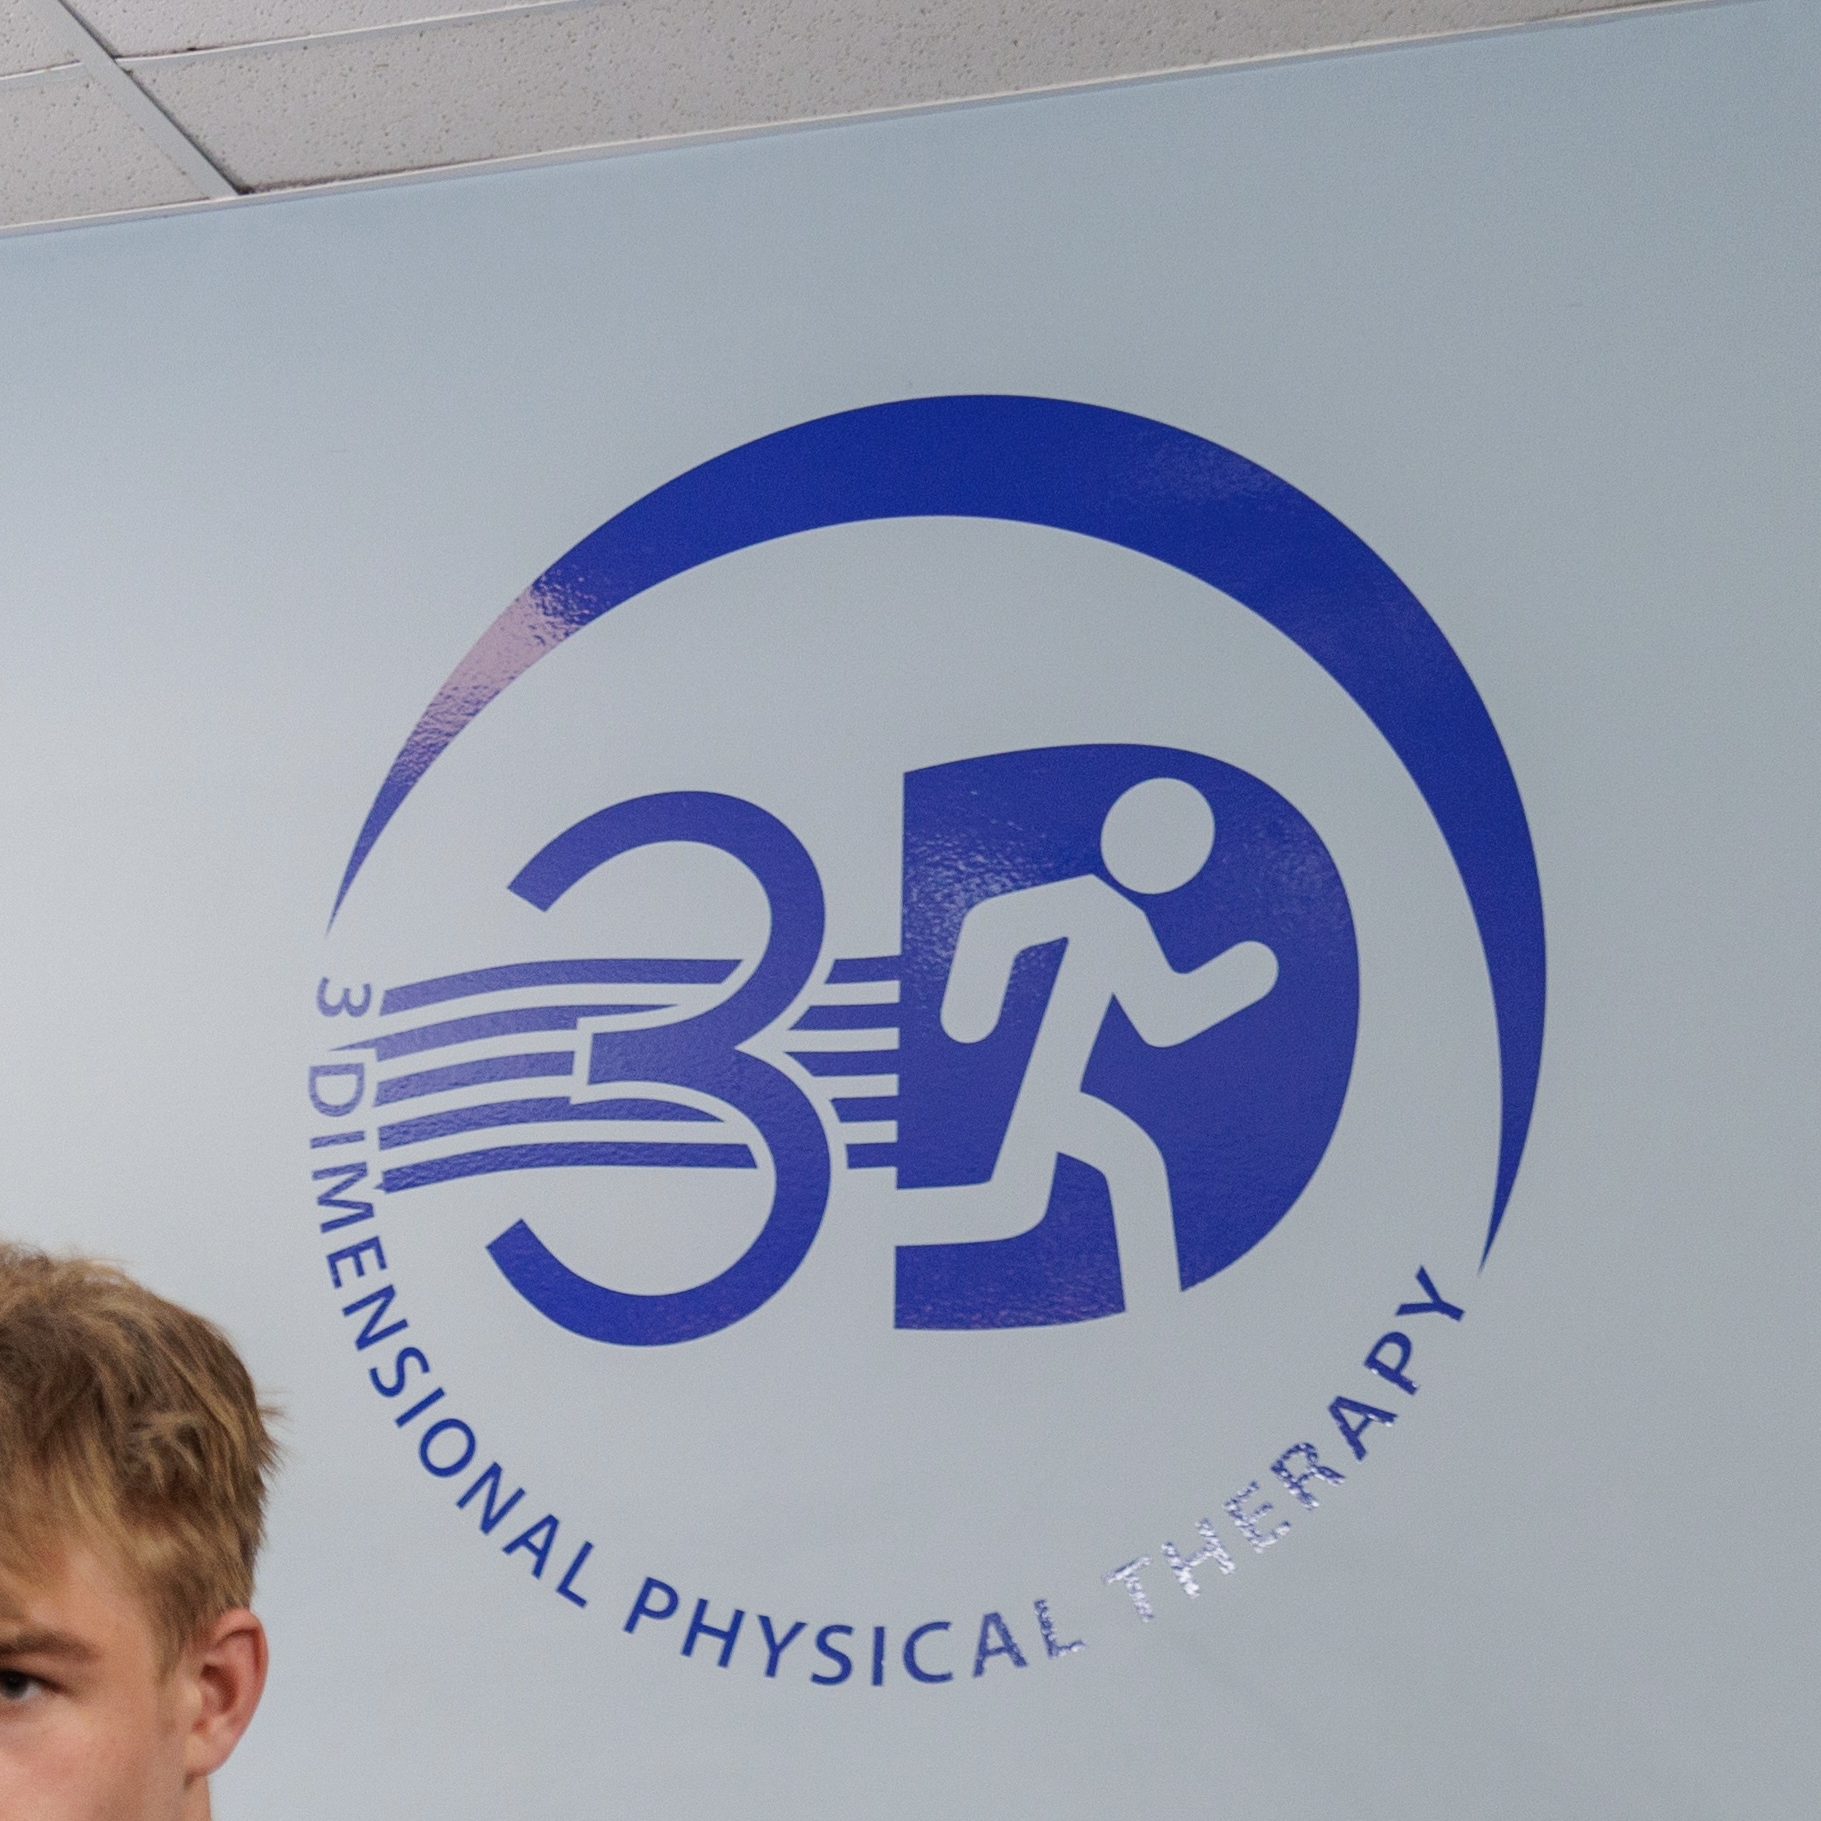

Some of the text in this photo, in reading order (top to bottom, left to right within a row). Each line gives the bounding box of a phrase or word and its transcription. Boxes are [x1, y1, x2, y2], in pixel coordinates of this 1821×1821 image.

[307, 976, 1466, 1687] 3 DIMENSIONAL PHYSICAL THERAPY
[485, 743, 1360, 1347] 3D
